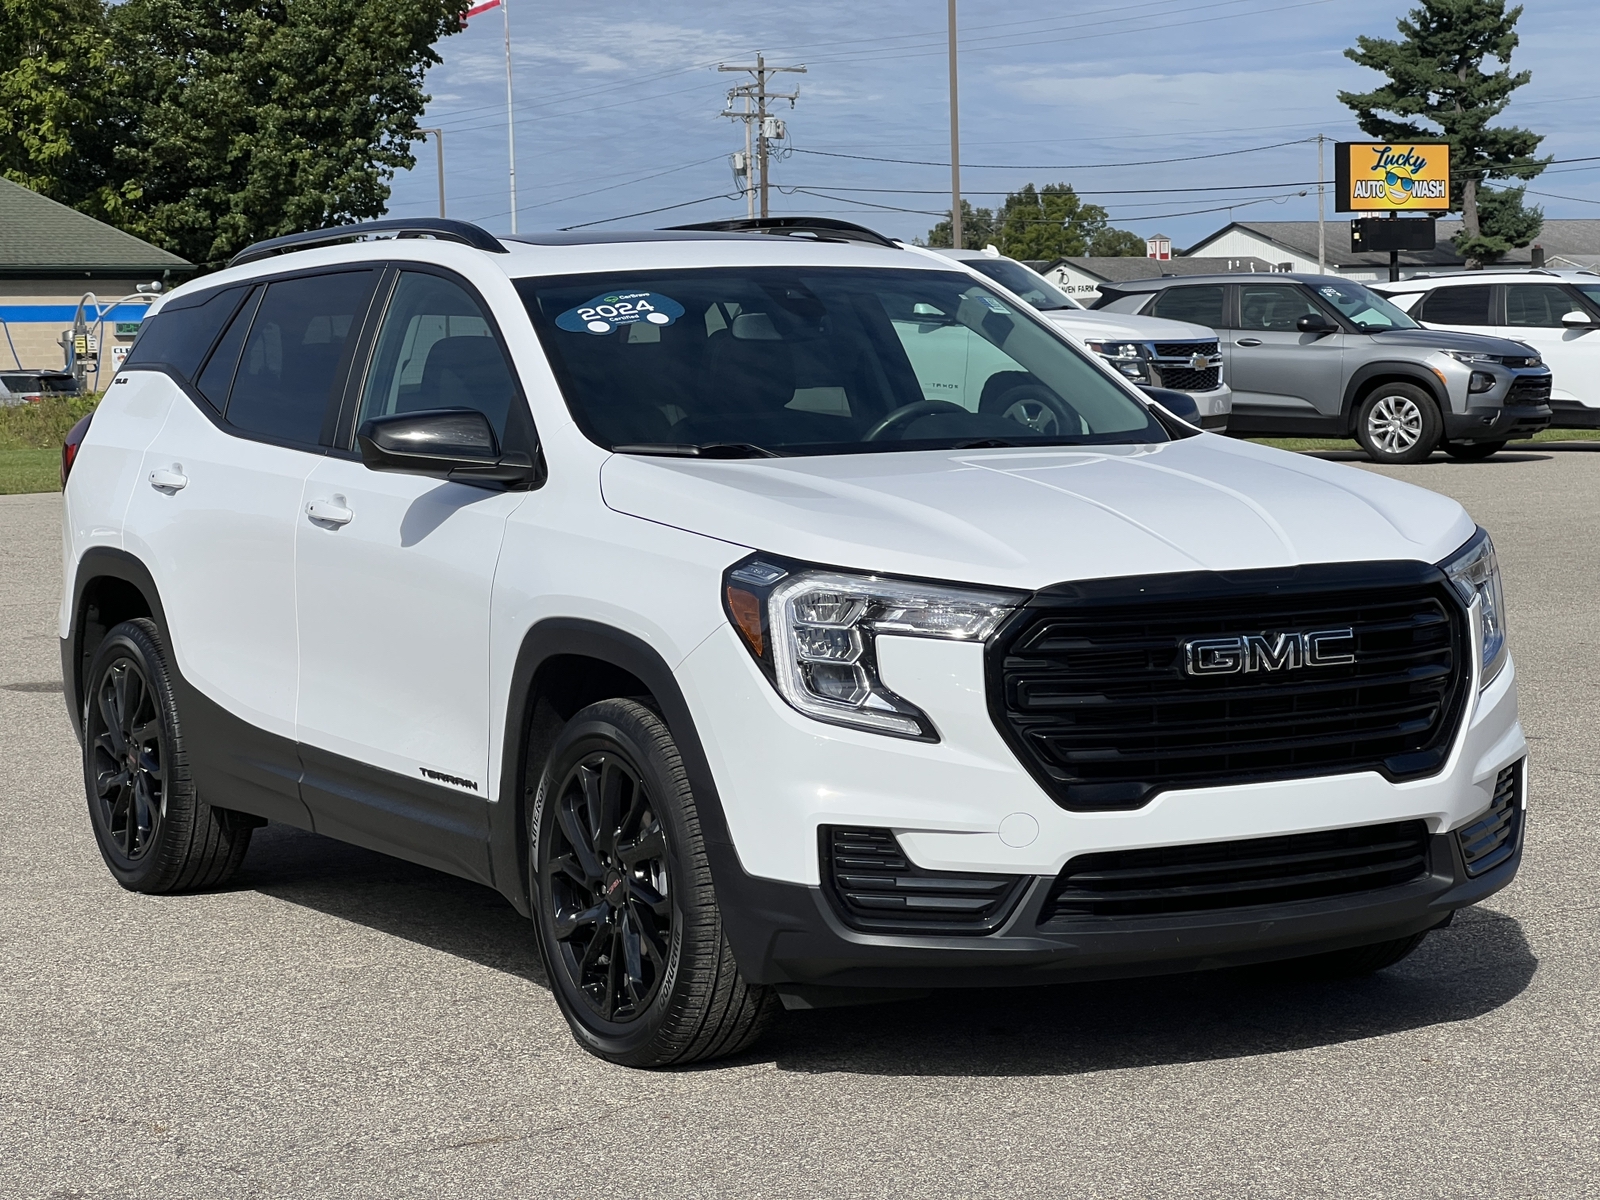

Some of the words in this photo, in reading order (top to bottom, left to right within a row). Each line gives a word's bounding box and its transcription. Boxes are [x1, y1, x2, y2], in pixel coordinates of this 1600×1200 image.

[1371, 146, 1427, 174] Lucky
[1353, 180, 1386, 198] AUTO
[1411, 180, 1446, 198] WASH
[577, 300, 655, 320] 2024
[1184, 627, 1356, 676] GMC
[418, 767, 478, 791] TERRAIN
